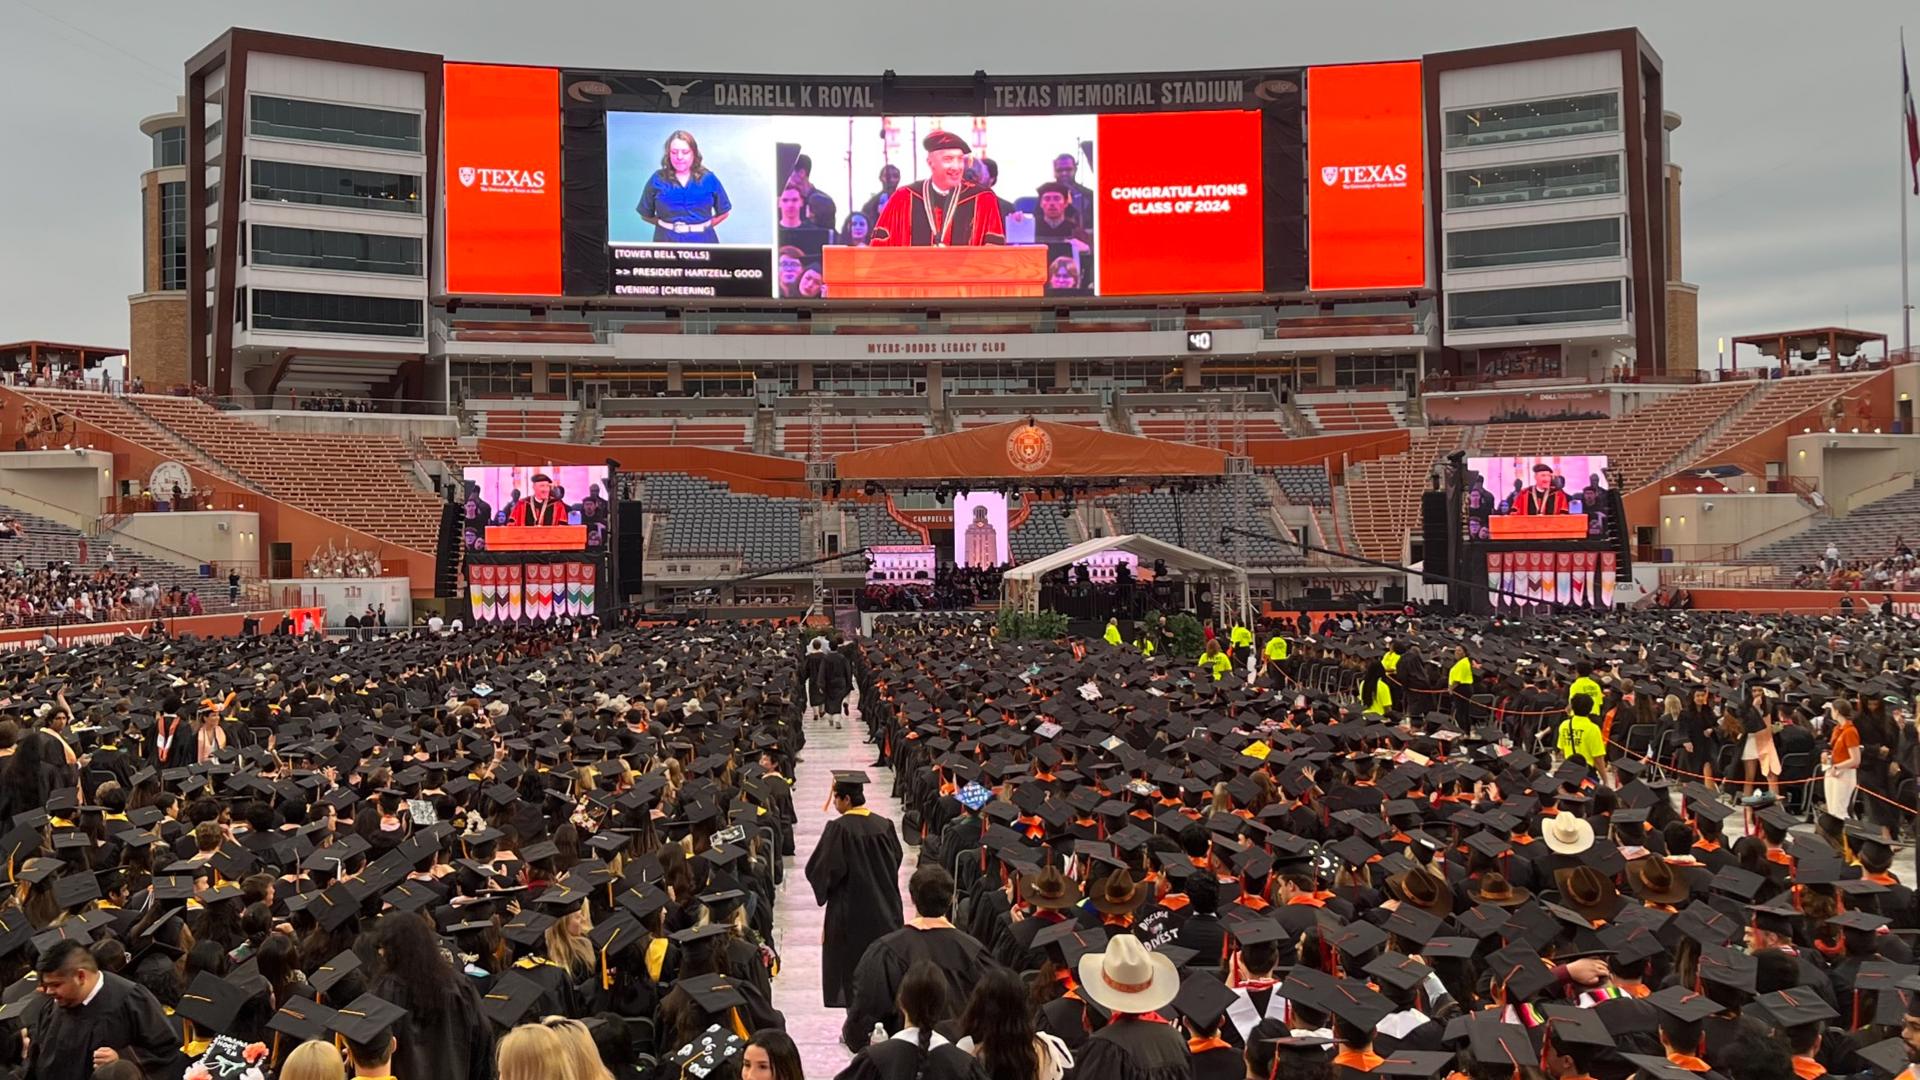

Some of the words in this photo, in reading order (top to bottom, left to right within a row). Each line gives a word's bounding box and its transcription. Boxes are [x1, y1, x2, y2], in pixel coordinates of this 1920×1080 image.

[714, 83, 795, 107] DARRELL
[800, 85, 812, 107] K
[818, 85, 874, 108] ROYAL
[993, 85, 1051, 108] TEXAS
[1057, 83, 1155, 107] MEMORIAL
[1161, 80, 1244, 104] STADIUM
[477, 169, 544, 187] TEXAS
[1340, 164, 1407, 182] TEXAS
[1111, 184, 1247, 199] CONGRATULATIONS
[1128, 202, 1172, 214] CLASS
[1174, 201, 1192, 213] OF
[1194, 200, 1230, 213] 2024
[614, 249, 652, 259] [TOWER
[654, 250, 676, 259] BELL
[677, 250, 710, 260] TOLLS]
[632, 267, 682, 277] PRESIDENT
[684, 268, 732, 277] HARTZELL:
[734, 269, 763, 278] GOOD
[615, 285, 658, 294] EVENING!
[661, 286, 714, 296] [CHEERING]
[867, 343, 937, 353] MYERS-DODDS
[941, 342, 978, 353] LEGACY
[981, 342, 1006, 353] CLUB
[1189, 333, 1211, 350] 40
[1358, 580, 1378, 592] XV
[1143, 928, 1179, 952] DIVEST
